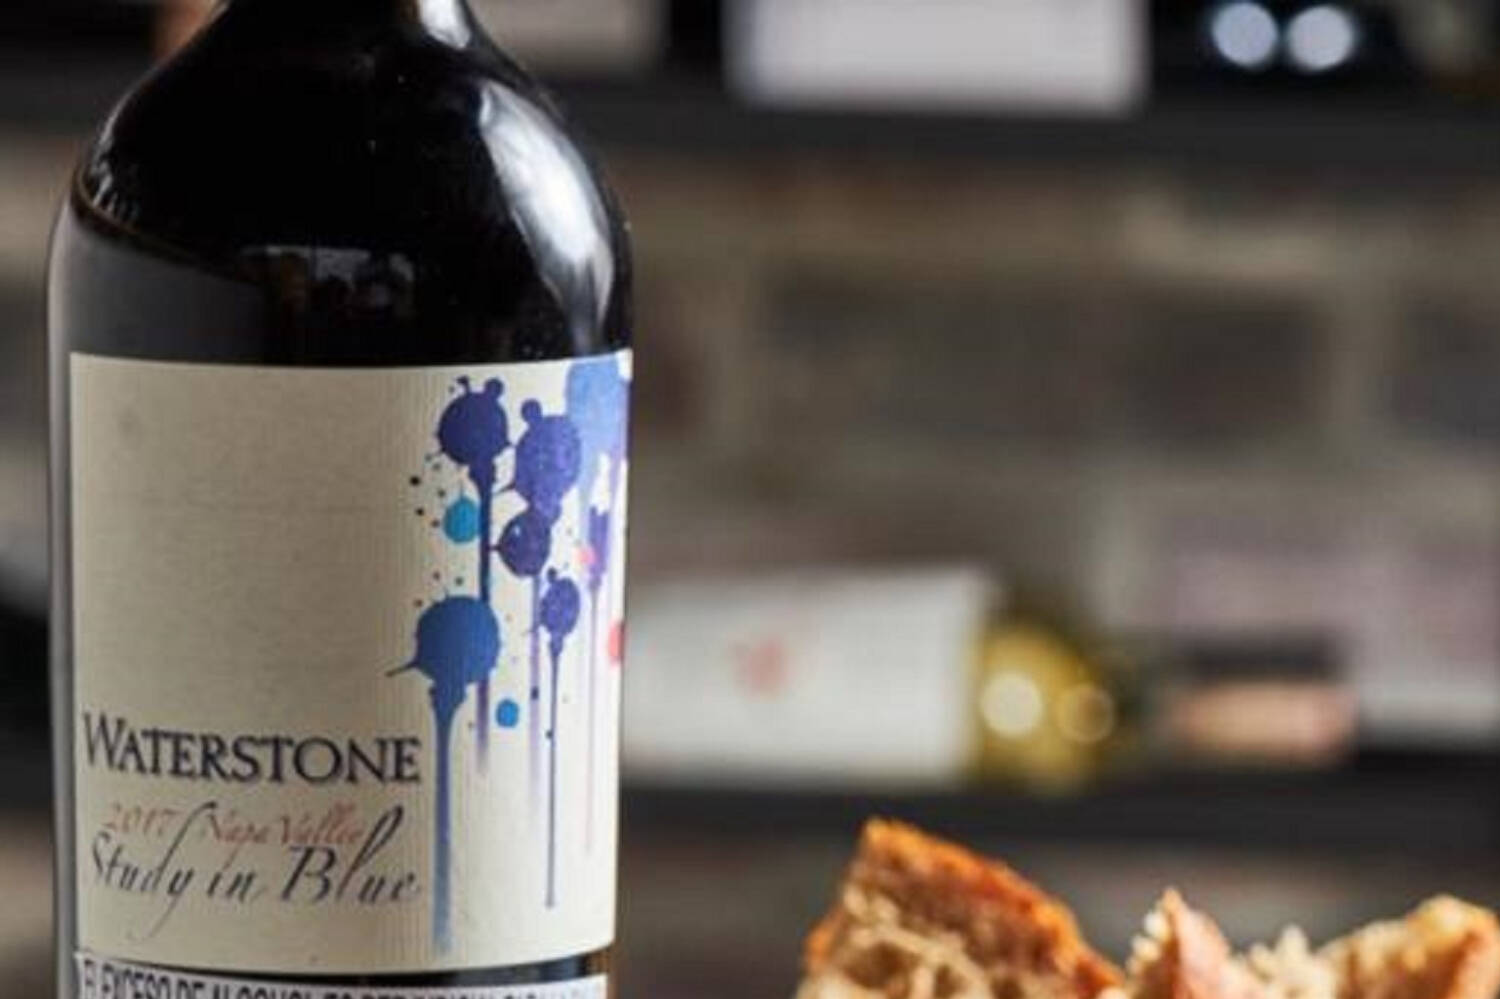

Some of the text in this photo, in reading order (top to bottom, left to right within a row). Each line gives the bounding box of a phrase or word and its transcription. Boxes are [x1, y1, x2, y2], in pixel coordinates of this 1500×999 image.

[84, 710, 422, 785] WATERSTONE
[91, 801, 422, 942] Study in Blue
